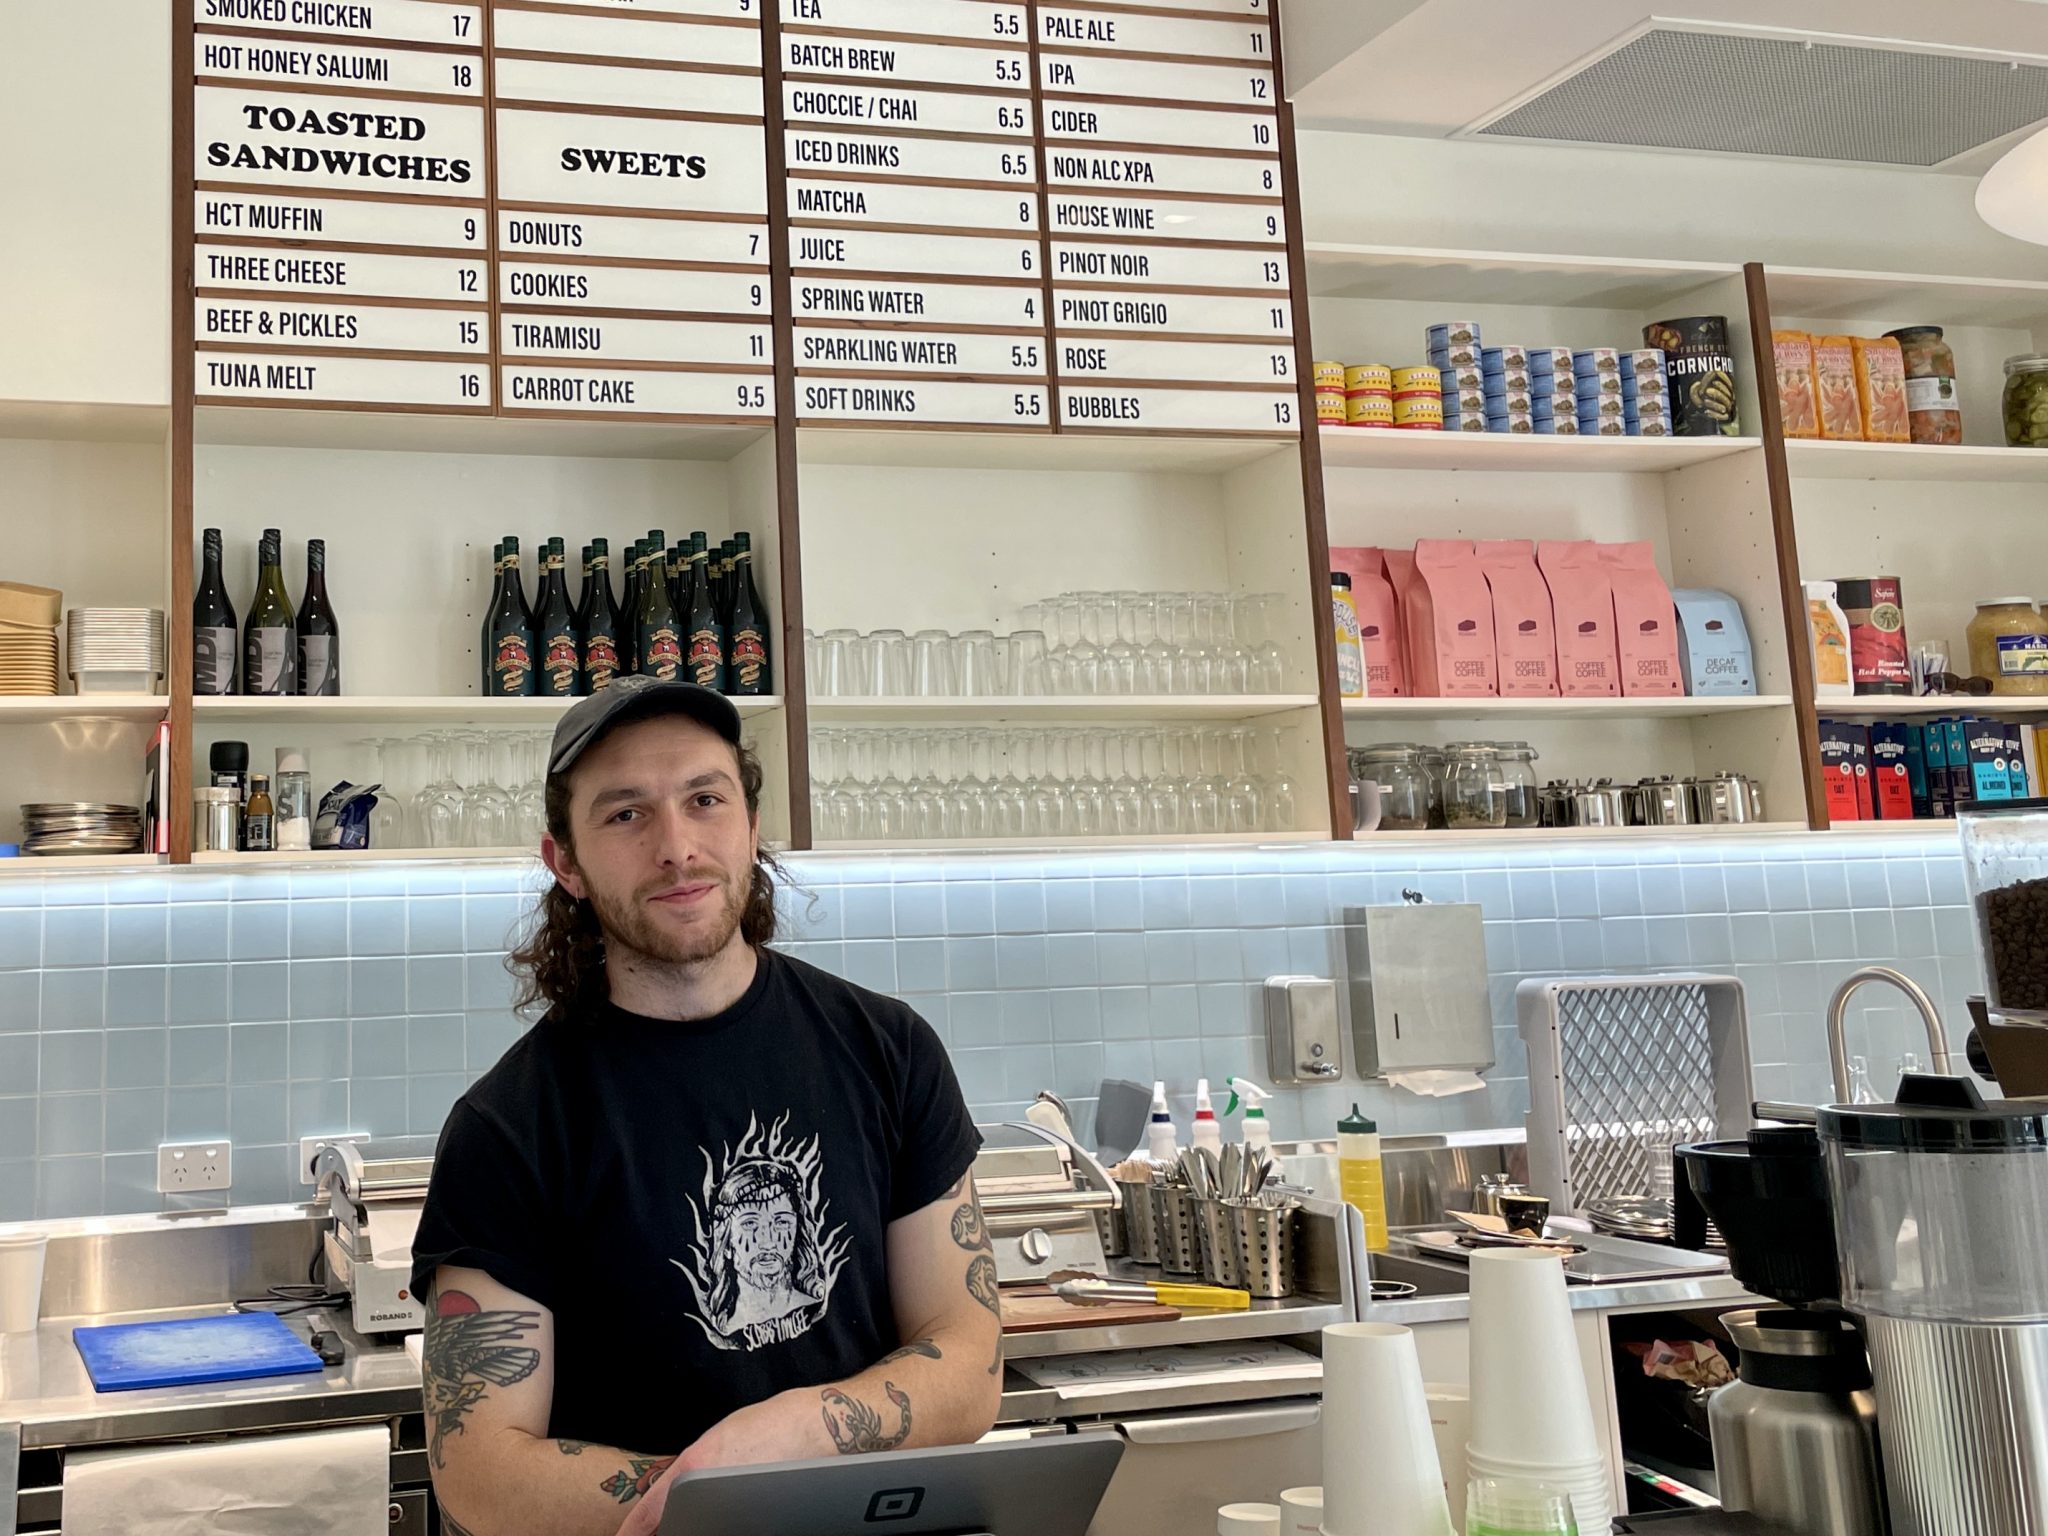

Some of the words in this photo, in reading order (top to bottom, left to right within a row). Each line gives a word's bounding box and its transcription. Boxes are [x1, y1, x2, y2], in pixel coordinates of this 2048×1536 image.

[206, 0, 285, 21] SMOKED
[291, 0, 372, 30] CHICKEN
[452, 14, 471, 37] 17
[993, 13, 1019, 35] 5.5
[1045, 16, 1084, 40] PALE
[1087, 19, 1116, 42] ALE
[1250, 32, 1263, 53] 11
[205, 44, 243, 70] HOT
[248, 48, 312, 76] HONEY
[316, 53, 388, 82] SALUMI
[452, 64, 472, 88] 18
[790, 43, 843, 69] BATCH
[848, 48, 895, 72] BREW
[996, 59, 1022, 81] 5.5
[1049, 63, 1075, 85] IPA
[1250, 78, 1267, 99] 12
[242, 104, 426, 142] TOASTED
[793, 91, 864, 117] CHOCCIE
[868, 97, 875, 119] /
[879, 97, 917, 121] CHAI
[998, 106, 1024, 129] 6.5
[1051, 110, 1098, 134] CIDER
[1252, 124, 1270, 145] 10
[207, 143, 470, 184] SANDWICHES
[560, 147, 706, 179] SWEETS
[795, 139, 833, 163] ICED
[837, 142, 900, 168] DRINKS
[1001, 153, 1027, 176] 6.5
[1053, 156, 1088, 179] NON
[1091, 159, 1121, 181] ALC
[1123, 160, 1154, 183] XPA
[1262, 169, 1273, 190] 8
[797, 188, 867, 214] MATCHA
[1019, 201, 1030, 223] 8
[1056, 204, 1110, 228] HOUSE
[1112, 207, 1155, 230] WINE
[1266, 216, 1276, 236] 9
[249, 204, 322, 232] MUFFIN
[464, 218, 476, 241] 9
[509, 220, 583, 248] DONUTS
[749, 234, 759, 256] 7
[799, 237, 845, 262] JUICE
[1021, 249, 1032, 271] 6
[1059, 251, 1107, 275] PINOT
[1110, 254, 1149, 277] NOIR
[1263, 262, 1280, 283] 13
[207, 254, 270, 282] THREE
[274, 258, 346, 286] CHEESE
[458, 269, 478, 292] 12
[510, 272, 588, 299] COOKIES
[750, 284, 761, 307] 9
[801, 287, 864, 312] SPRING
[868, 290, 924, 315] WATER
[1024, 298, 1035, 319] 4
[207, 308, 253, 334] BEEF
[258, 311, 274, 335] &
[279, 312, 358, 339] PICKLES
[459, 321, 479, 344] 15
[1062, 299, 1110, 322] PINOT
[1113, 301, 1167, 325] GRIGIO
[1270, 308, 1284, 329] 11
[511, 324, 601, 351] TIRAMISU
[749, 334, 763, 357] 11
[804, 337, 898, 363] SPARKLING
[901, 341, 957, 365] WATER
[1012, 345, 1038, 368] 5.5
[1065, 347, 1107, 370] ROSE
[1270, 355, 1287, 376] 13
[207, 362, 261, 388] TUNA
[267, 365, 317, 391] MELT
[459, 374, 480, 398] 16
[512, 376, 584, 402] CARROT
[588, 379, 635, 404] CAKE
[737, 385, 765, 408] 9.5
[805, 386, 848, 410] SOFT
[852, 388, 916, 412] DRINKS
[1014, 394, 1040, 416] 5.5
[1068, 396, 1140, 420] BUBBLES
[1274, 402, 1291, 424] 13
[1454, 660, 1485, 669] COFFEE
[1455, 669, 1486, 677] COFFEE
[1514, 660, 1546, 669] COFFEE
[1515, 669, 1547, 677] COFFEE
[1575, 661, 1606, 669] COFFEE
[1576, 669, 1607, 678] COFFEE
[1637, 660, 1668, 668] COFFEE
[1638, 668, 1669, 676] COFFEE
[1705, 666, 1739, 675] COFFEE
[1706, 658, 1736, 666] DECAF
